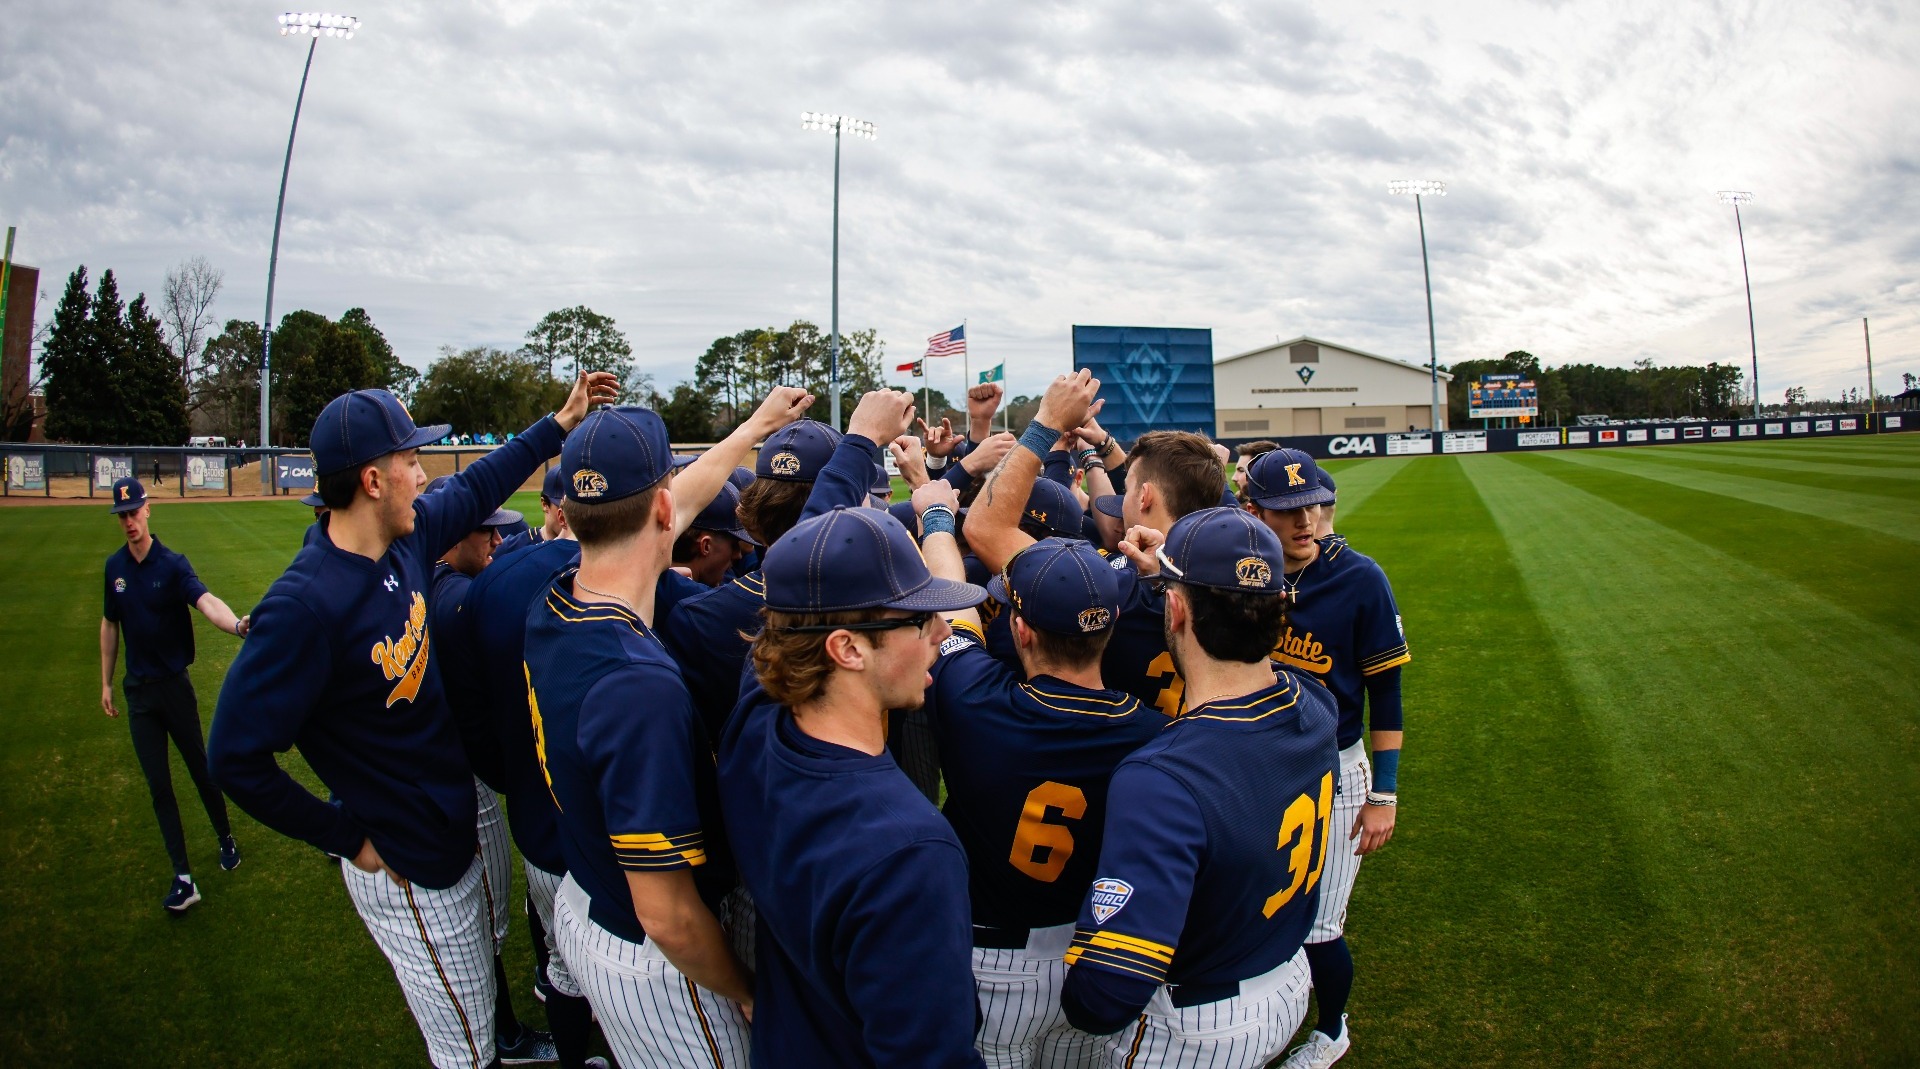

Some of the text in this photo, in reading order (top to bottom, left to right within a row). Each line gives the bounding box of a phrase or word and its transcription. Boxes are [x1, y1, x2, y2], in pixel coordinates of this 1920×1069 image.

[1328, 436, 1376, 455] CAA
[25, 467, 42, 477] SCALF
[101, 465, 110, 476] 42
[115, 461, 126, 469] CARL
[193, 465, 202, 475] 47
[204, 468, 225, 477] BROOKS
[291, 468, 313, 477] CAA
[1284, 463, 1306, 487] K
[119, 485, 131, 500] K
[1243, 563, 1264, 581] K
[371, 620, 417, 681] Kent
[1146, 651, 1188, 719] 3
[1008, 780, 1088, 884] 6
[1261, 770, 1333, 920] 31
[1092, 892, 1126, 907] MAC
